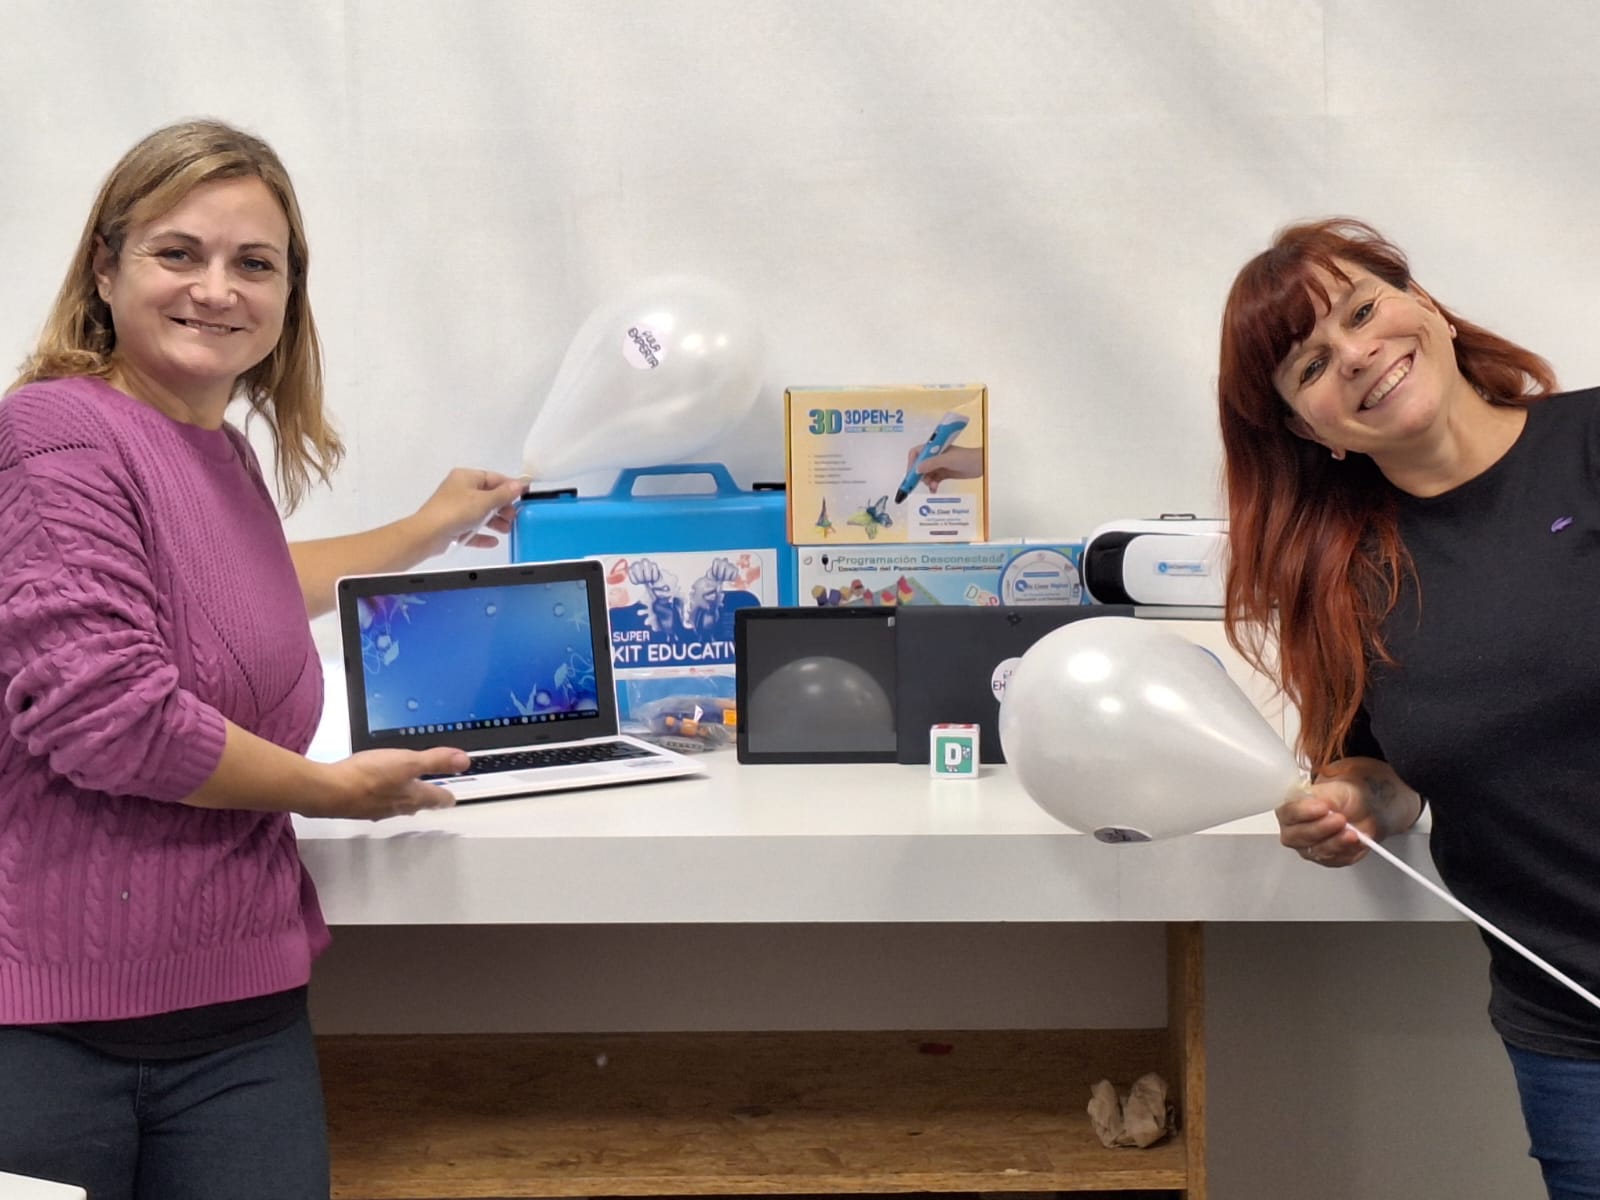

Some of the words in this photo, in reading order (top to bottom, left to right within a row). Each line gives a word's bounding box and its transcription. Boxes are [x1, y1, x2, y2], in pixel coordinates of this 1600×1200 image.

[808, 408, 843, 435] 3D
[844, 409, 904, 425] 3DPEN-2
[837, 555, 917, 566] Programación
[921, 554, 1004, 565] Desconectada
[613, 630, 650, 642] SUPER
[612, 645, 642, 663] KIT
[944, 742, 962, 766] D
